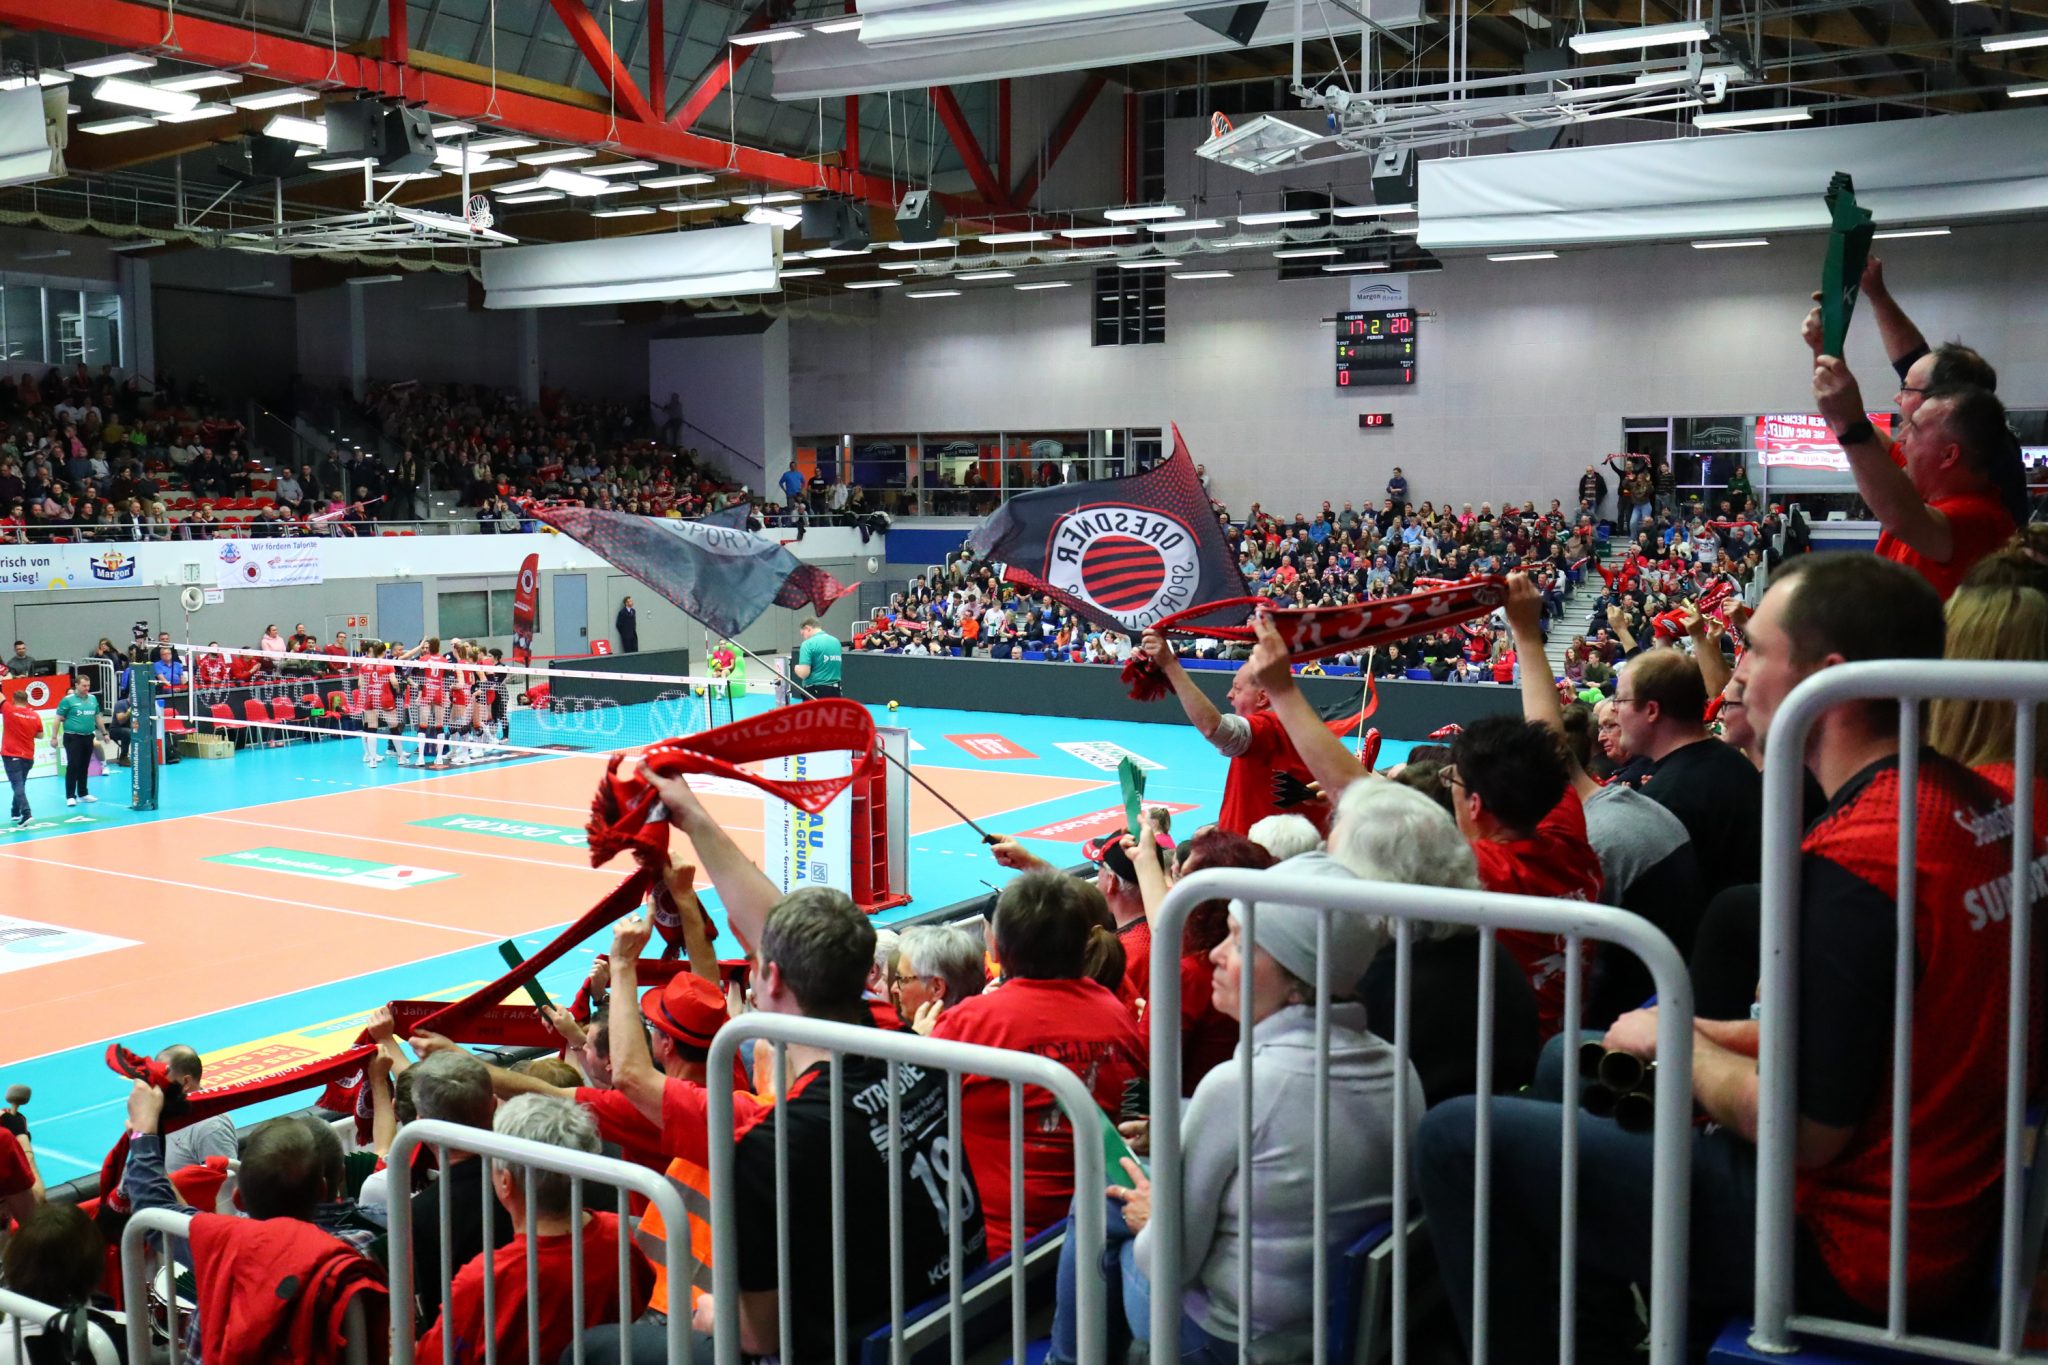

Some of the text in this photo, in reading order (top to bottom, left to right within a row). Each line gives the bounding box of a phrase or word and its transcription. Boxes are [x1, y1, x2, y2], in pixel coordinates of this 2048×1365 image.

[1357, 293, 1381, 301] Margon
[1349, 320, 1364, 334] 17
[1371, 319, 1380, 334] 2
[1390, 318, 1410, 334] 20
[1339, 370, 1349, 385] 0
[1405, 369, 1410, 382] 1
[251, 543, 264, 551] Wir
[31, 557, 50, 567] von
[12, 572, 39, 584] Sieg!
[97, 567, 130, 580] Margon
